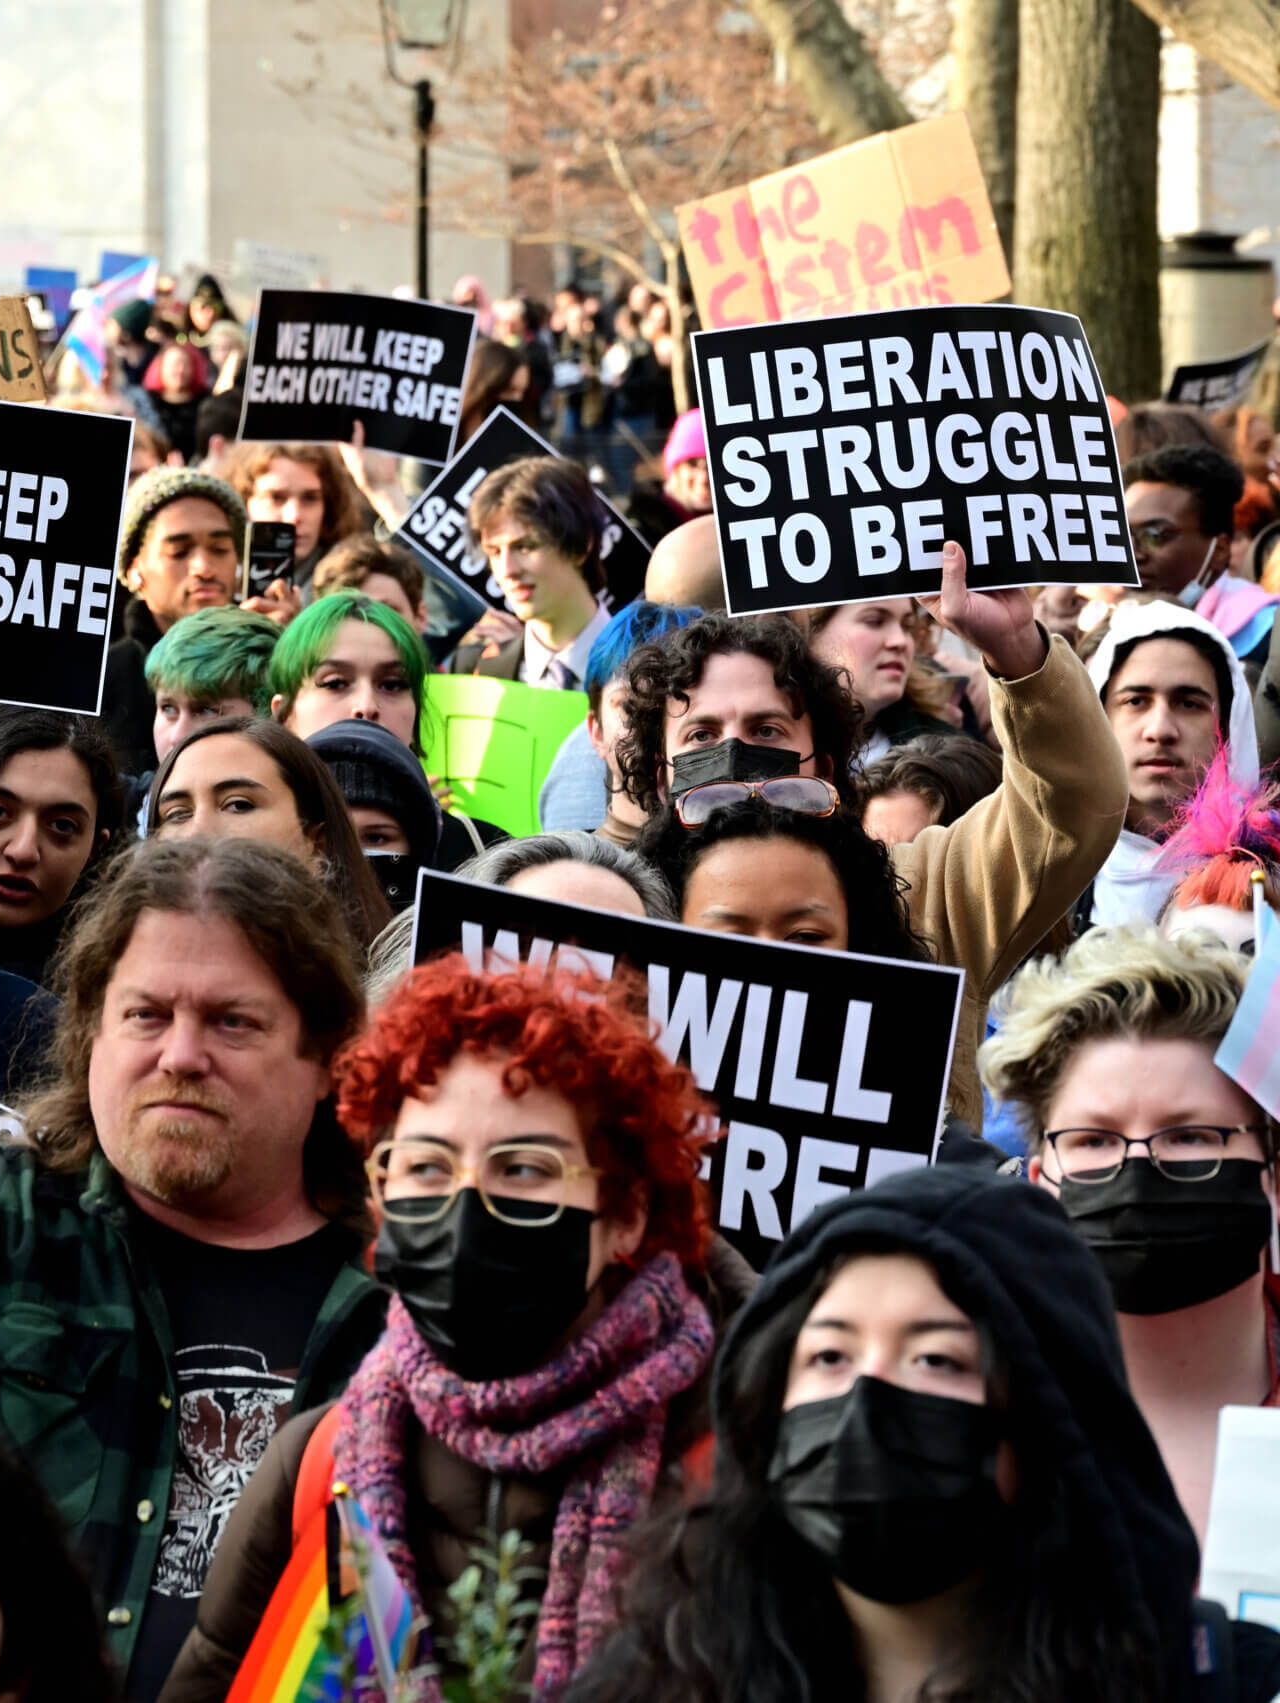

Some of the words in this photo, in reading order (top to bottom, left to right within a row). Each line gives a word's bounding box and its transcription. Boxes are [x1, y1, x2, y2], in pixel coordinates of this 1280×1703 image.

[687, 173, 821, 267] the
[248, 364, 307, 405] EACH
[308, 366, 392, 413] OTHER
[393, 376, 462, 427] SAFE
[276, 321, 311, 361] WE
[312, 322, 367, 365] WILL
[372, 327, 445, 377] KEEP
[707, 330, 1099, 427] LIBERATION
[721, 411, 1113, 508] STRUGGLE
[728, 511, 832, 590] TO
[850, 498, 945, 577] BE
[966, 492, 1128, 566] FREE
[647, 963, 892, 1124] WILL
